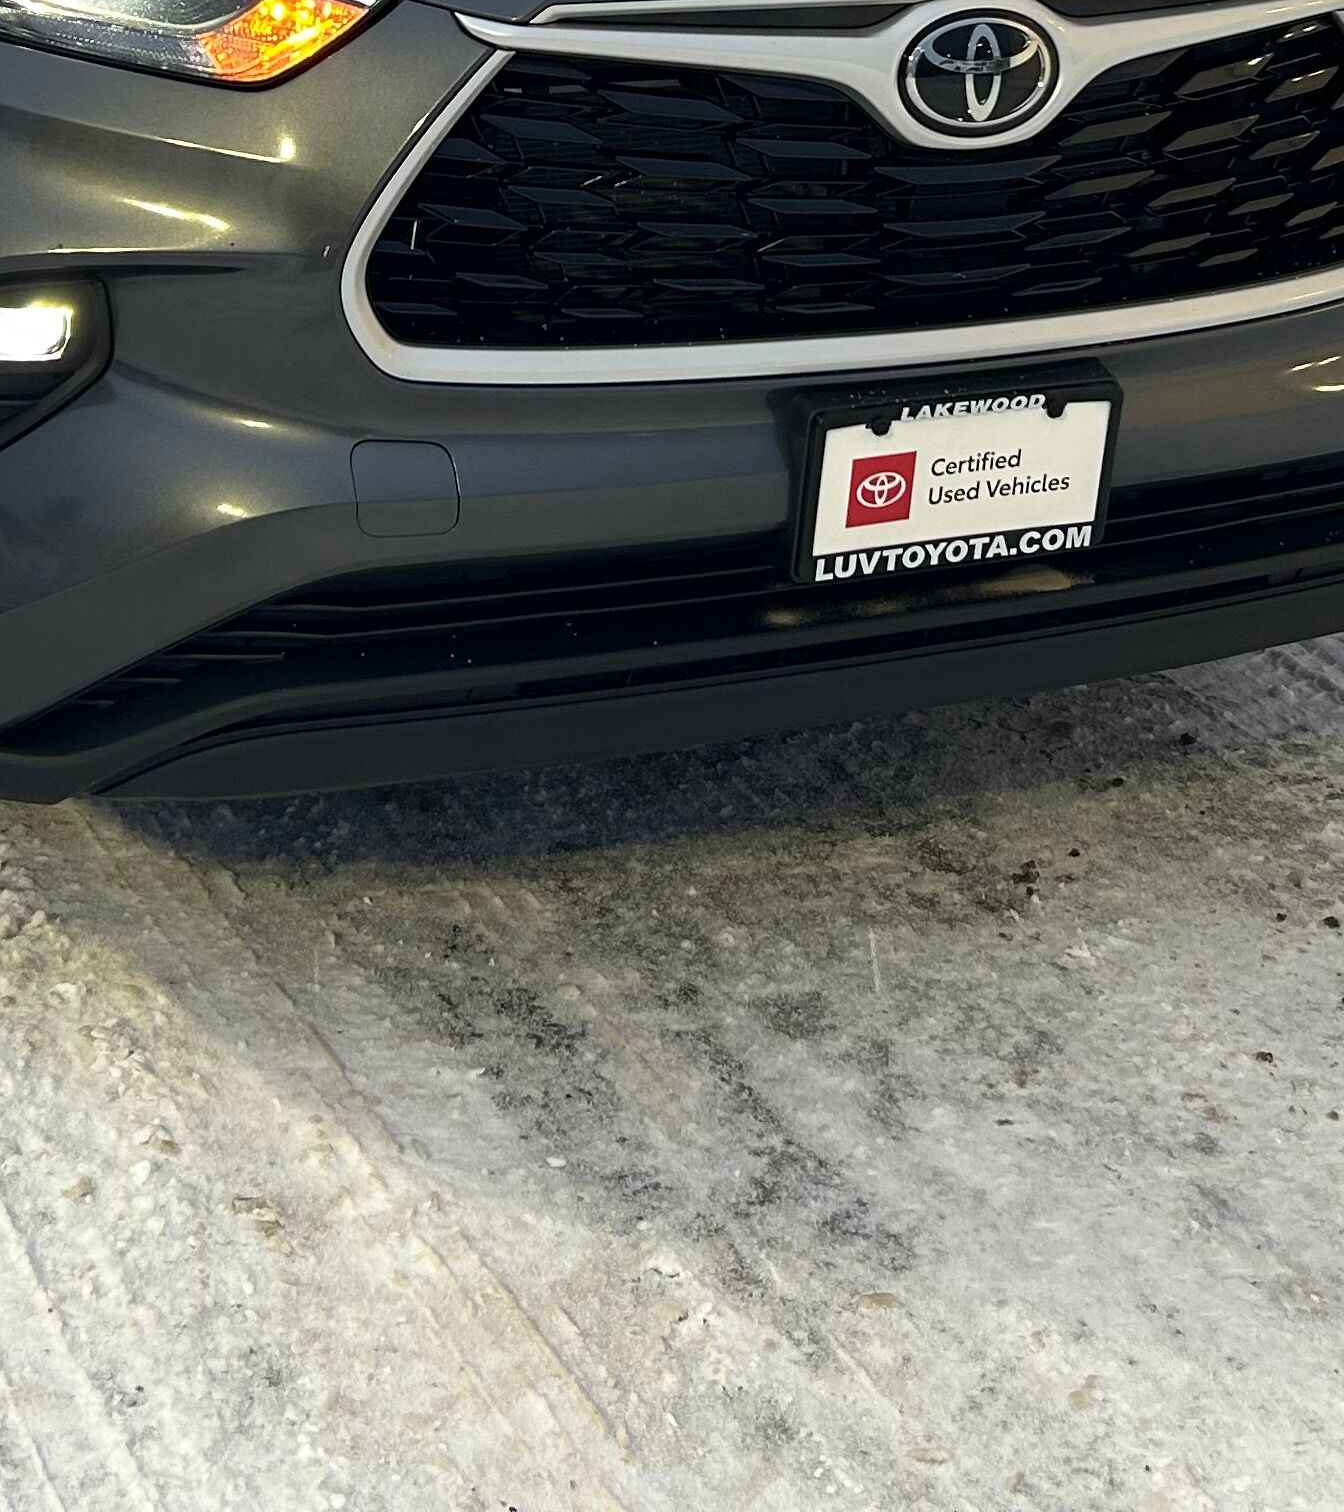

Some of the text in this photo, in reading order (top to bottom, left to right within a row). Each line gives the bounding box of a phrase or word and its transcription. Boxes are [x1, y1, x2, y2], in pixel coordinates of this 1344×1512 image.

[900, 393, 1047, 422] LAKEWOOD
[931, 448, 1023, 477] Certified
[928, 473, 1071, 506] Used Vehicles
[814, 525, 1094, 583] LUVTOYOTA.COM
